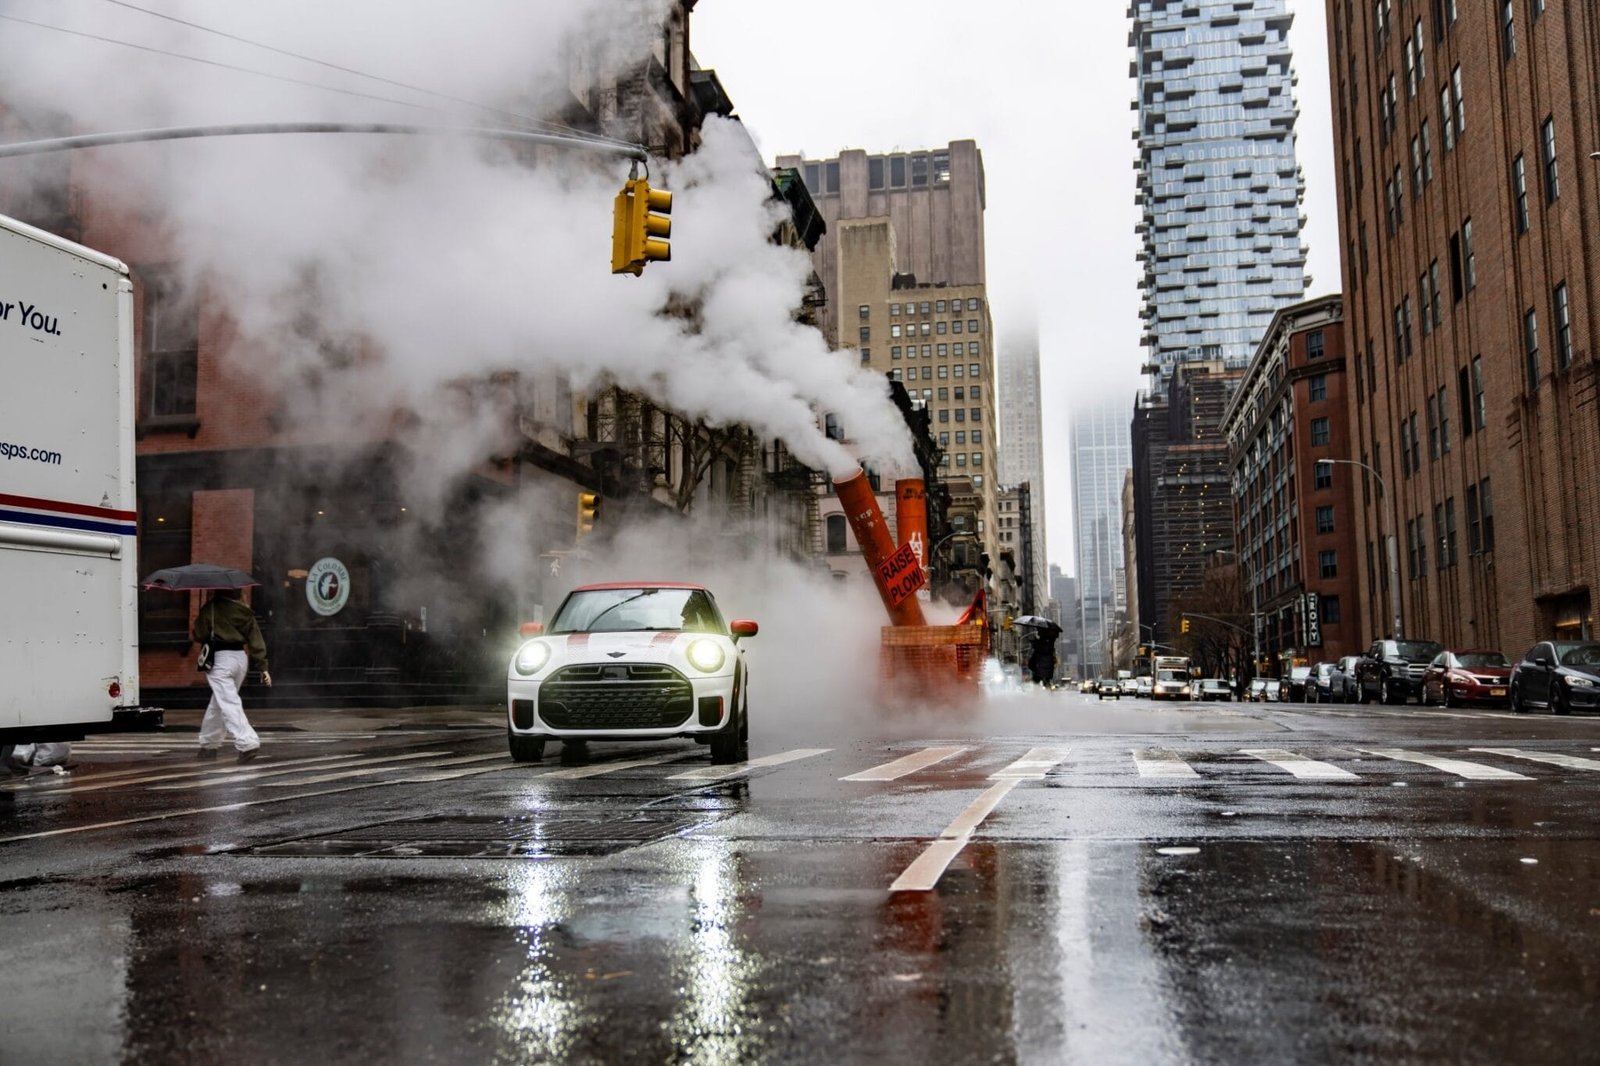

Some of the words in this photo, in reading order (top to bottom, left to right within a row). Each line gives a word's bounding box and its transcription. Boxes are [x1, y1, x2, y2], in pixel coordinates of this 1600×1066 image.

[0, 301, 14, 320] r
[19, 301, 61, 336] You.
[0, 442, 61, 465] sps.com
[881, 547, 913, 582] RAISE
[891, 568, 921, 602] PLOW
[1309, 601, 1318, 640] ROXY
